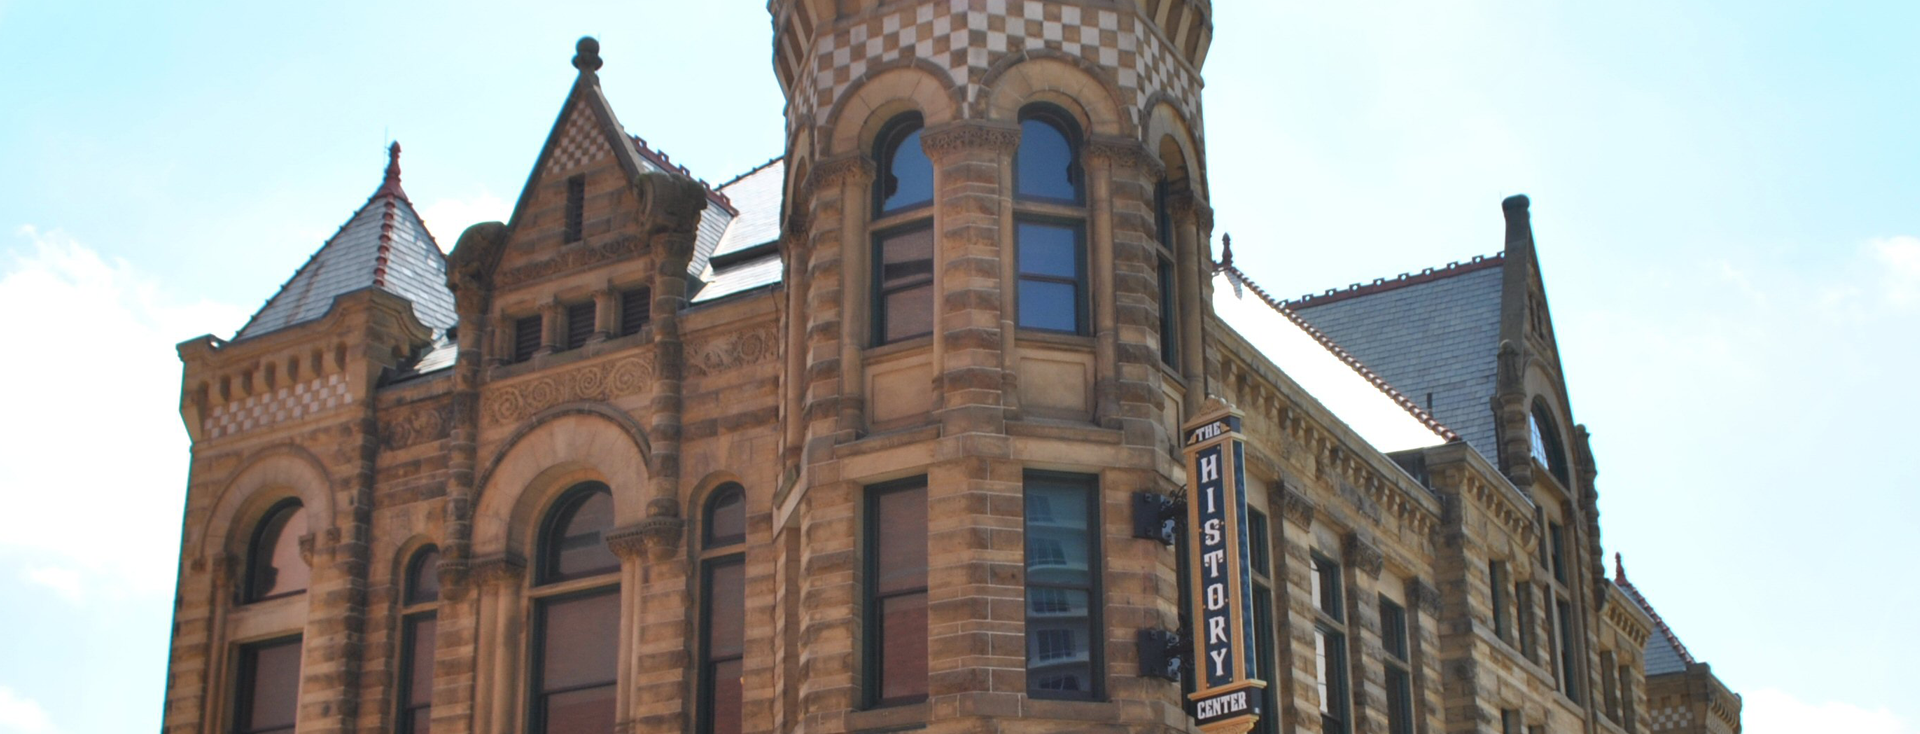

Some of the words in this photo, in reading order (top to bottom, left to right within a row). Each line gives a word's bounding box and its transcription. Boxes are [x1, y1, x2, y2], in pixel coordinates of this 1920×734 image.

[1196, 421, 1221, 441] THE
[1200, 454, 1228, 677] HISTORY
[1197, 691, 1247, 719] CENTER
